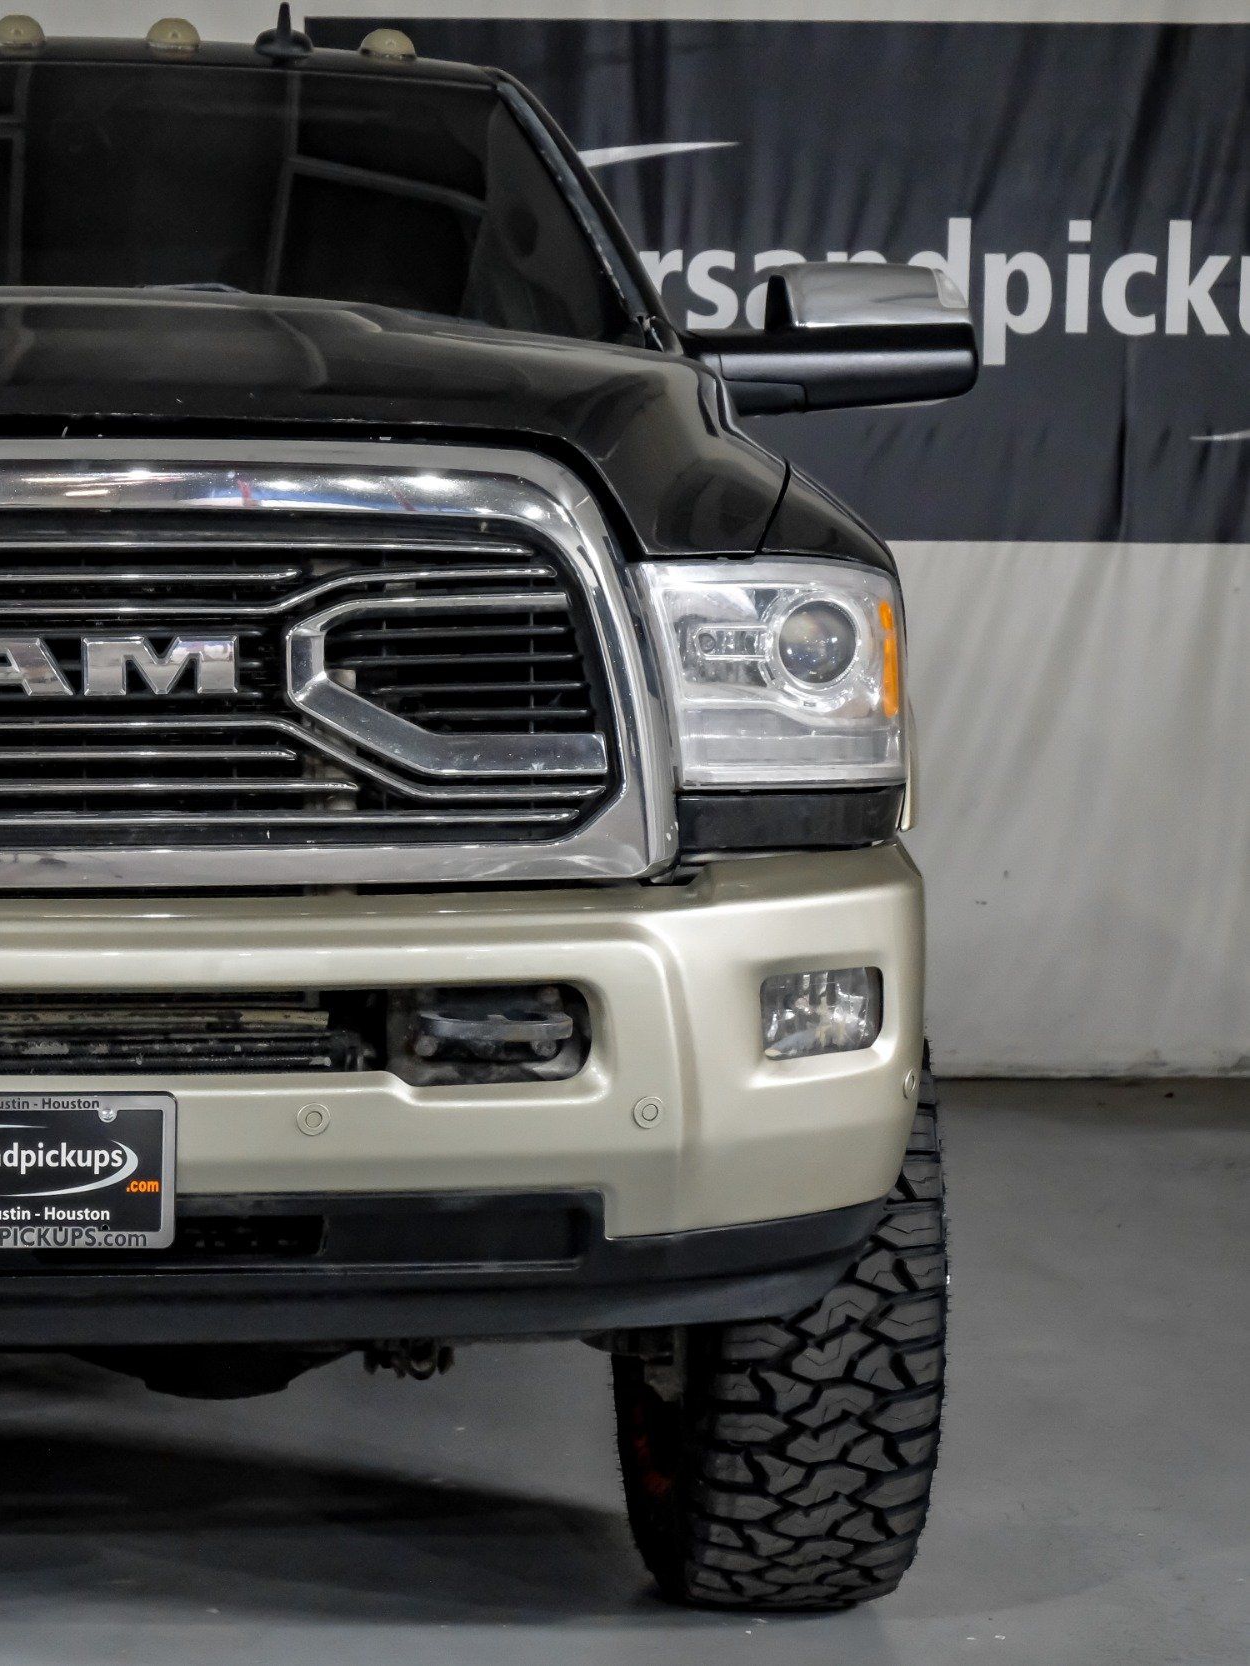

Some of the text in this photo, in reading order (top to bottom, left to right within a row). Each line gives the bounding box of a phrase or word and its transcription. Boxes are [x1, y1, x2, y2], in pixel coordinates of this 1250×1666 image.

[639, 218, 1250, 365] rspick
[41, 1097, 100, 1110] Houston
[126, 1180, 159, 1192] .com
[44, 1206, 110, 1221] Houston
